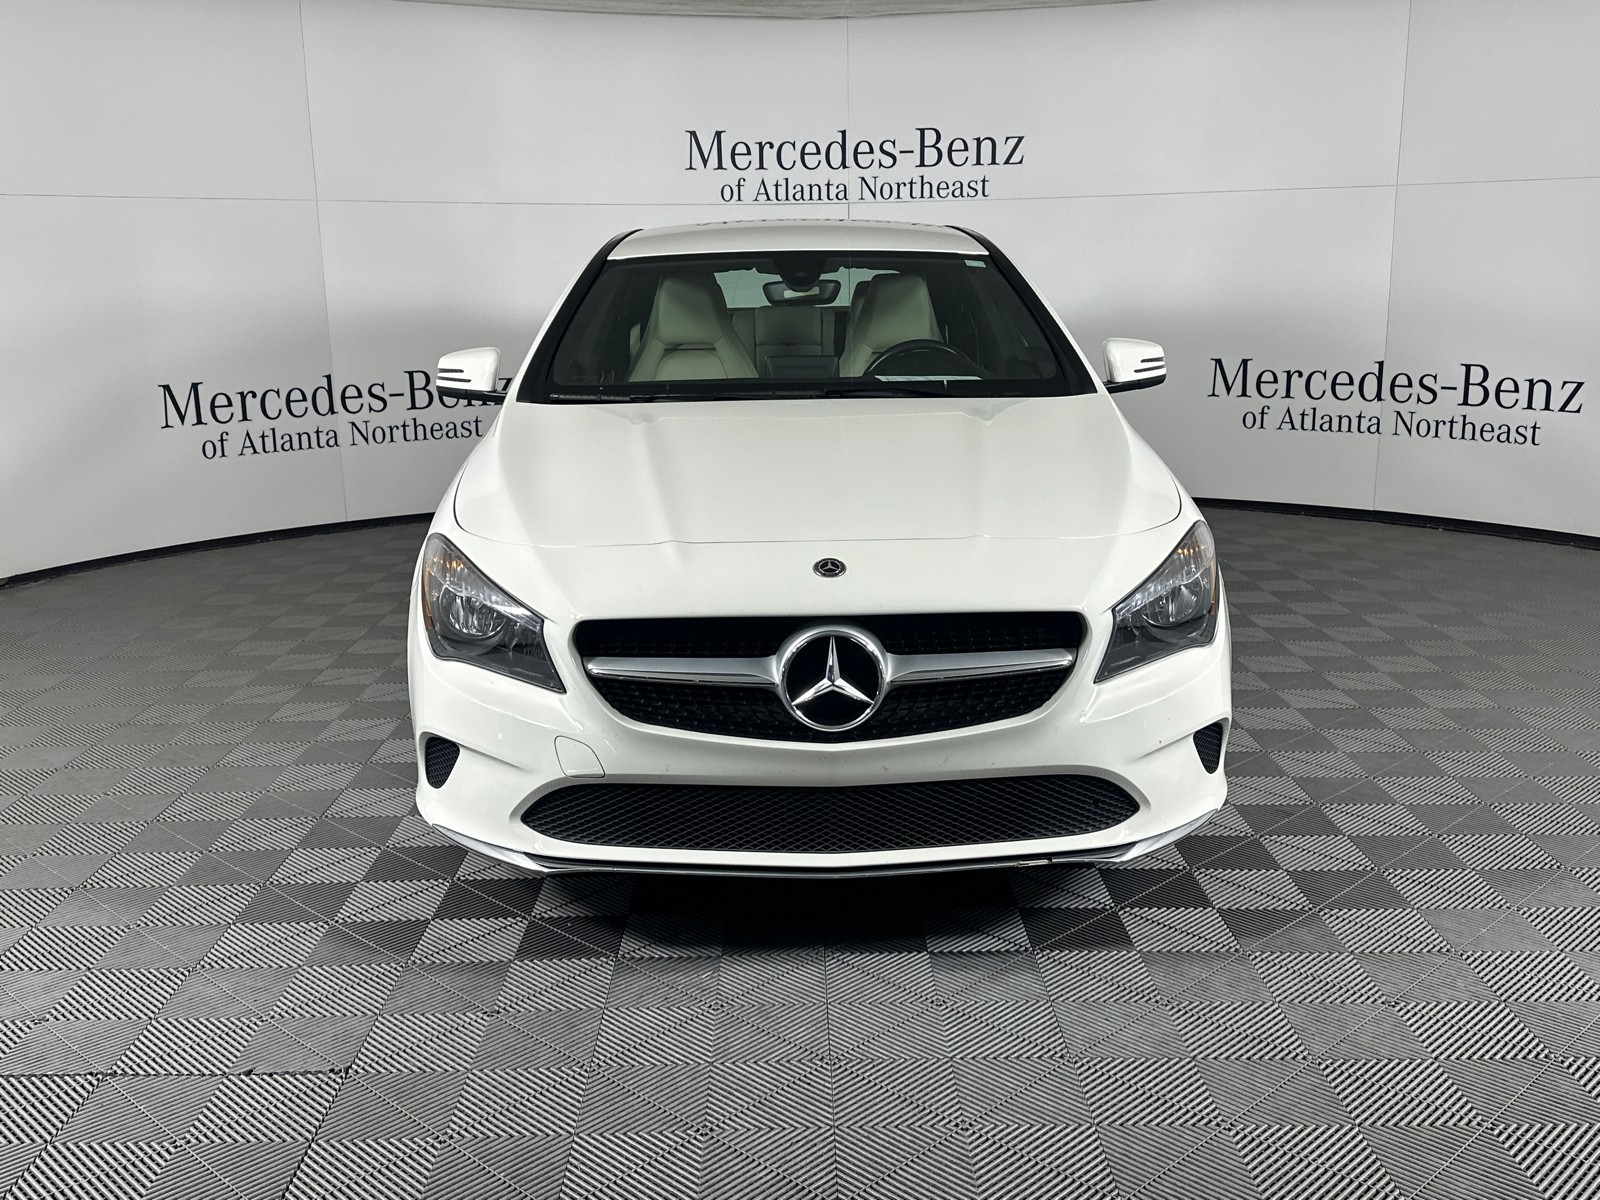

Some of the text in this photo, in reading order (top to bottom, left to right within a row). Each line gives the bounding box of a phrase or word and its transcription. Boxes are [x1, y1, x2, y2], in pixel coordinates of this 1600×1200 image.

[685, 127, 1025, 171] Mercedes-Benz
[720, 175, 990, 202] of Atlanta Northeast
[1207, 358, 1585, 414] Mercedes-Benz
[201, 415, 484, 460] of Atlanta Northeast
[1242, 405, 1541, 446] of Atlanta Northeast
